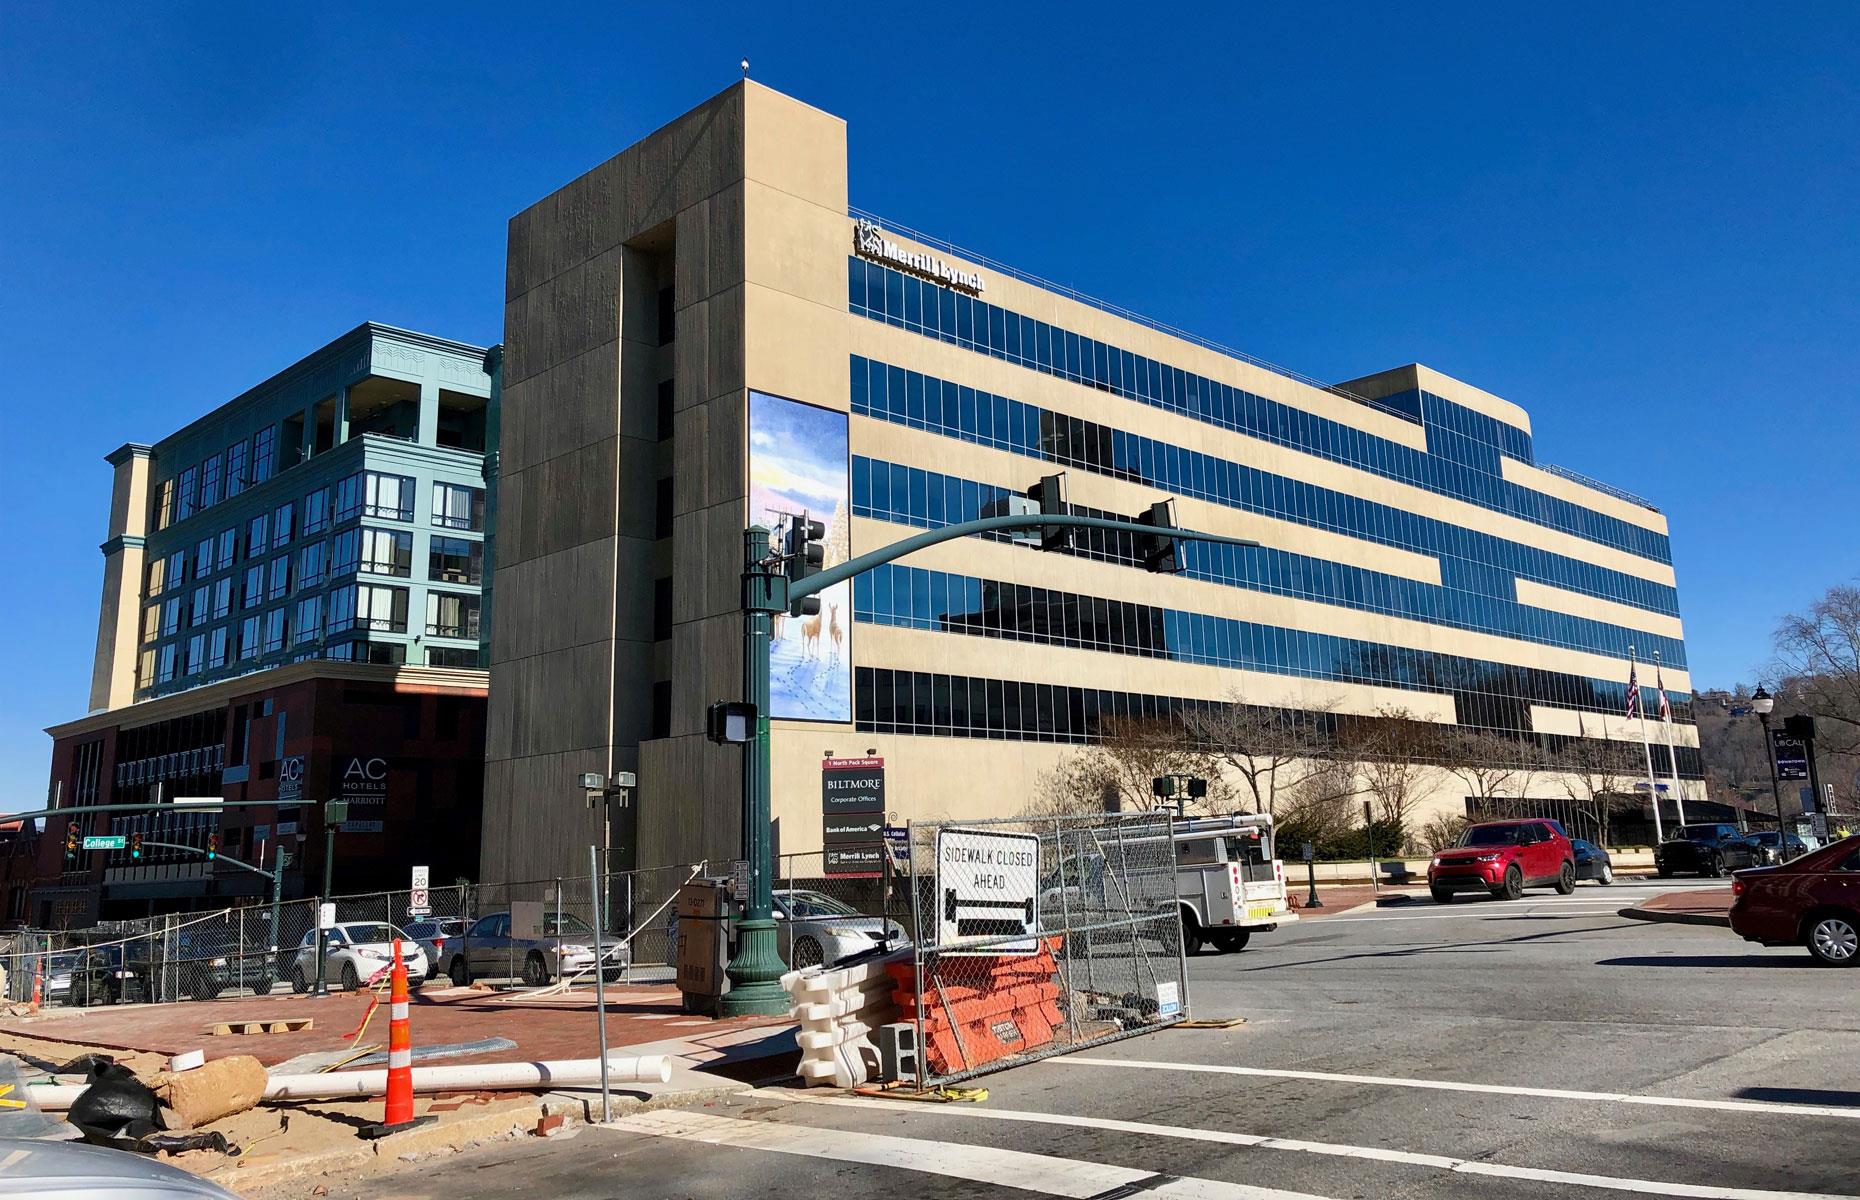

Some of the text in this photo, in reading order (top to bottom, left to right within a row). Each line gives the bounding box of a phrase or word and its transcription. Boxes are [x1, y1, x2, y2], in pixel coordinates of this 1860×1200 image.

[884, 240, 985, 290] Merrill Lynch
[280, 759, 299, 781] AC
[344, 758, 387, 780] AC
[343, 782, 386, 790] HOTELS
[827, 779, 881, 790] BILTMORE
[830, 796, 857, 804] Corporate
[85, 838, 115, 848] College
[840, 852, 880, 860] Merrill Lynch
[945, 846, 1033, 867] SIDEWALK CLOSED
[414, 877, 427, 887] 20
[973, 873, 1006, 889] AHEAD
